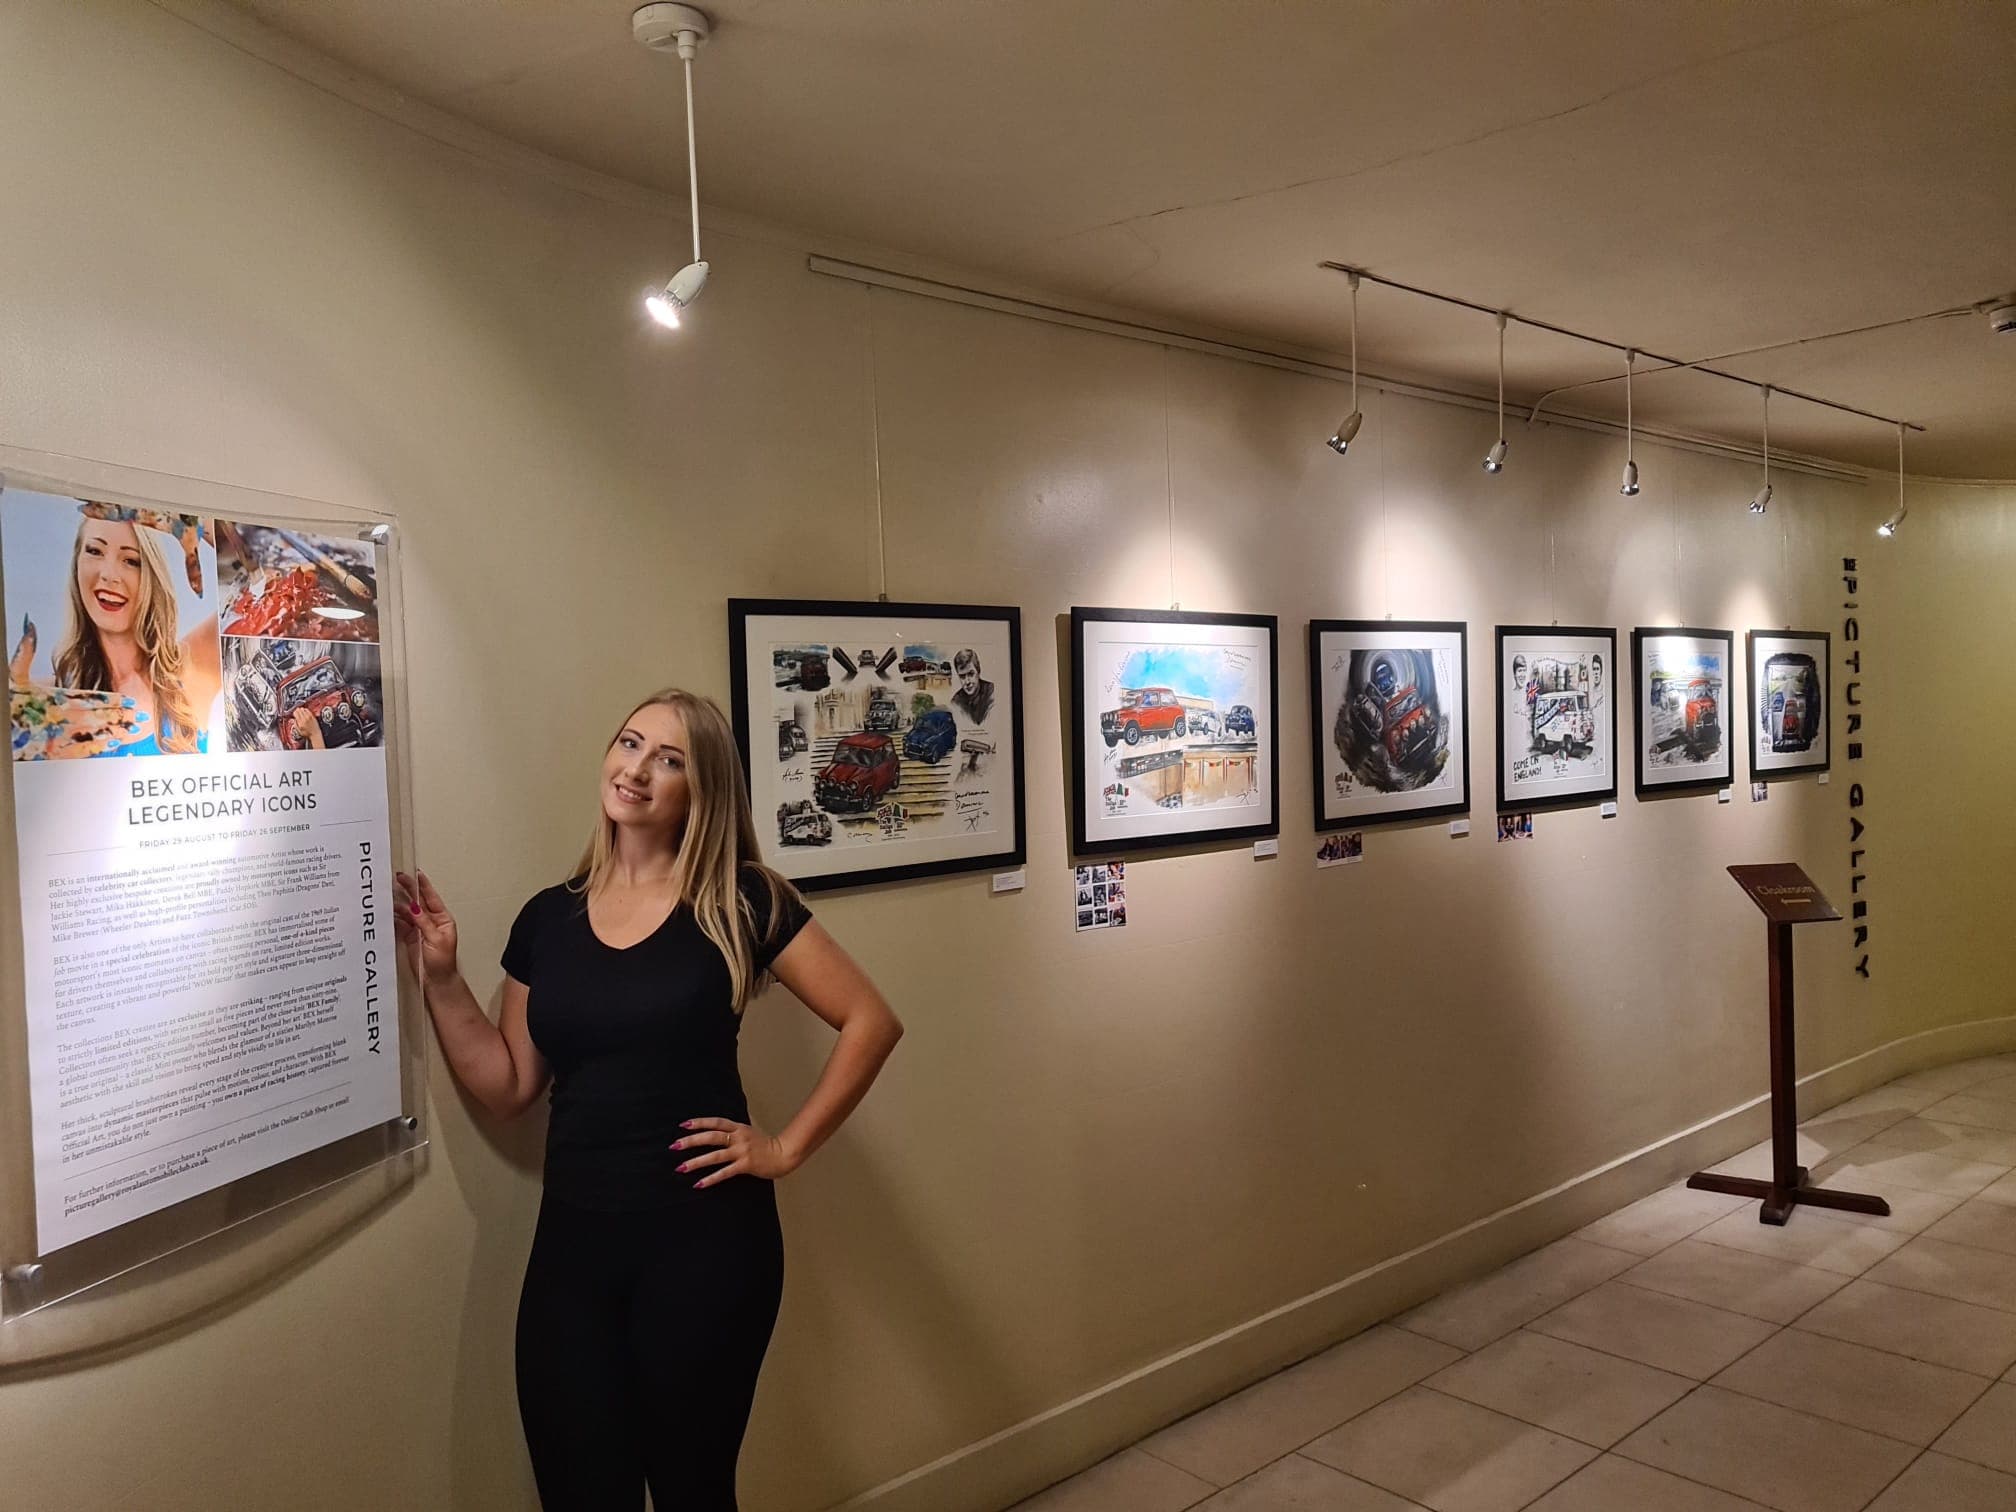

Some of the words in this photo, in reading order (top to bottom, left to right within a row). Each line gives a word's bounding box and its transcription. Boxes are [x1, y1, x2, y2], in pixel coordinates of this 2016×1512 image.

[1843, 576, 1863, 760] PICTURE
[131, 779, 174, 798] BEX
[182, 774, 273, 794] OFFICIAL
[278, 770, 313, 788] ART
[128, 797, 255, 825] LEGENDARY
[262, 793, 317, 813] ICONS
[138, 838, 170, 847] FRIDAY
[184, 833, 216, 842] AUGUST
[230, 829, 257, 837] FRIDAY
[269, 823, 310, 833] SEPTEMBER
[47, 877, 66, 887] BEX
[359, 841, 376, 942] PICTURE
[1849, 783, 1870, 978] GALLERY
[49, 901, 64, 909] Her
[52, 953, 70, 964] BEX
[119, 943, 131, 952] the
[234, 921, 248, 930] with
[105, 953, 130, 966] special
[192, 959, 207, 968] with
[208, 957, 227, 965] racing
[243, 959, 257, 968] style
[364, 950, 381, 1055] GALLERY
[55, 1022, 69, 1031] the
[247, 1016, 259, 1026] part
[267, 1011, 277, 1019] the
[56, 1043, 72, 1053] The
[113, 1028, 130, 1039] BEX
[94, 1040, 121, 1054] limited
[153, 1029, 169, 1039] with
[145, 1051, 161, 1062] BEX
[94, 1086, 111, 1098] with
[111, 1084, 124, 1093] the
[233, 1049, 247, 1059] style
[60, 1121, 75, 1130] Her
[240, 1067, 250, 1075] the
[103, 1112, 134, 1128] dynamic
[134, 1099, 179, 1117] masterpieces
[211, 1083, 226, 1093] with
[179, 1101, 206, 1116] painting
[243, 1085, 259, 1096] piece
[267, 1076, 285, 1086] racing
[63, 1194, 77, 1204] For
[78, 1185, 104, 1198] further
[201, 1144, 218, 1157] piece
[237, 1131, 256, 1144] please
[256, 1125, 269, 1135] visit
[270, 1122, 279, 1130] the
[300, 1109, 313, 1119] Club
